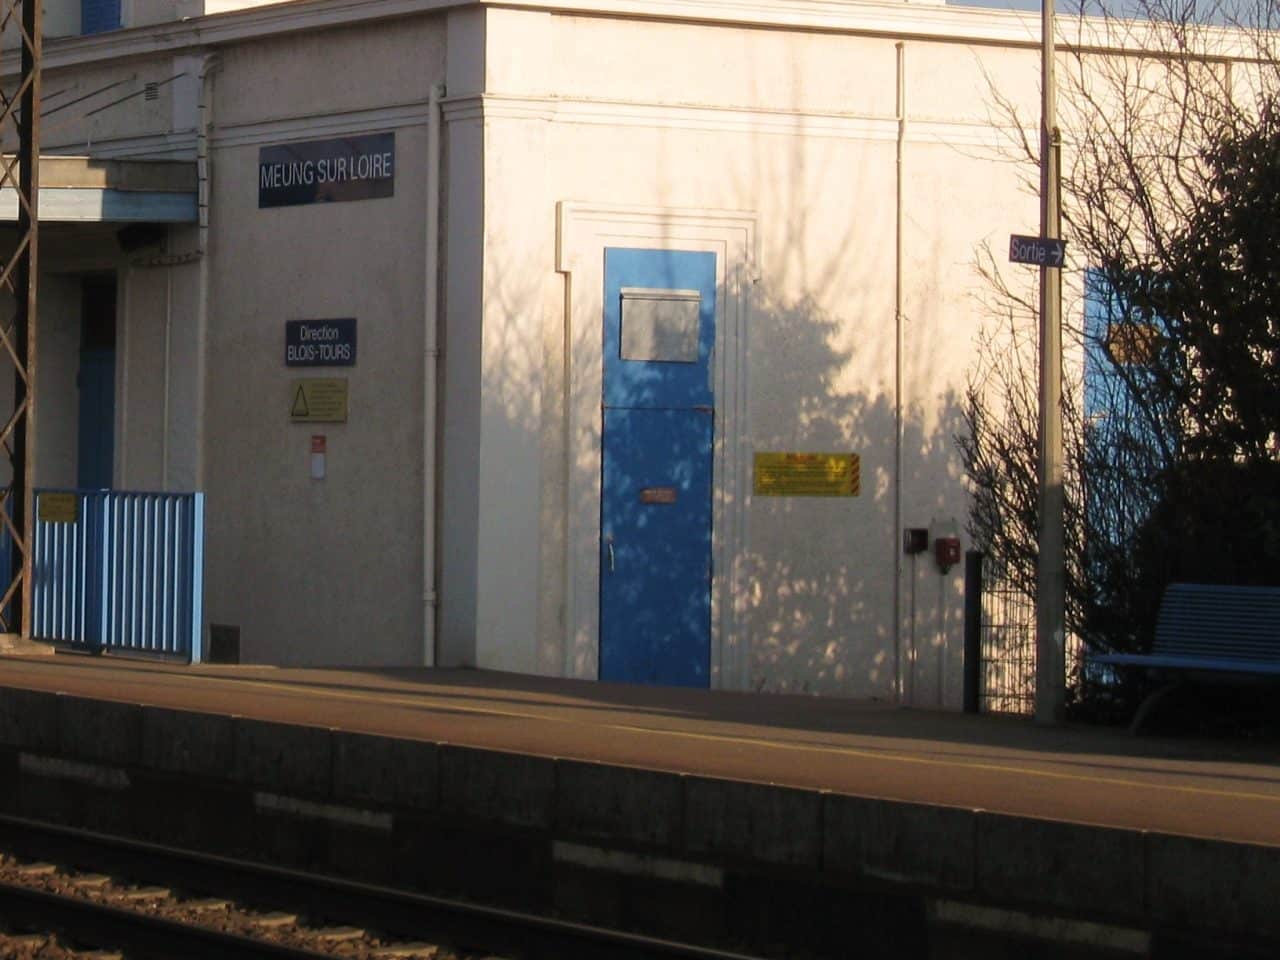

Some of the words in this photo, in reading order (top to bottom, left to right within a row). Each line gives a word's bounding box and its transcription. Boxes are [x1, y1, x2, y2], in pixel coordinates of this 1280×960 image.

[261, 161, 313, 188] MEUNG
[317, 157, 347, 183] SUR
[350, 152, 392, 180] LOIRE
[1011, 239, 1046, 261] Sortie
[300, 325, 339, 340] Direction
